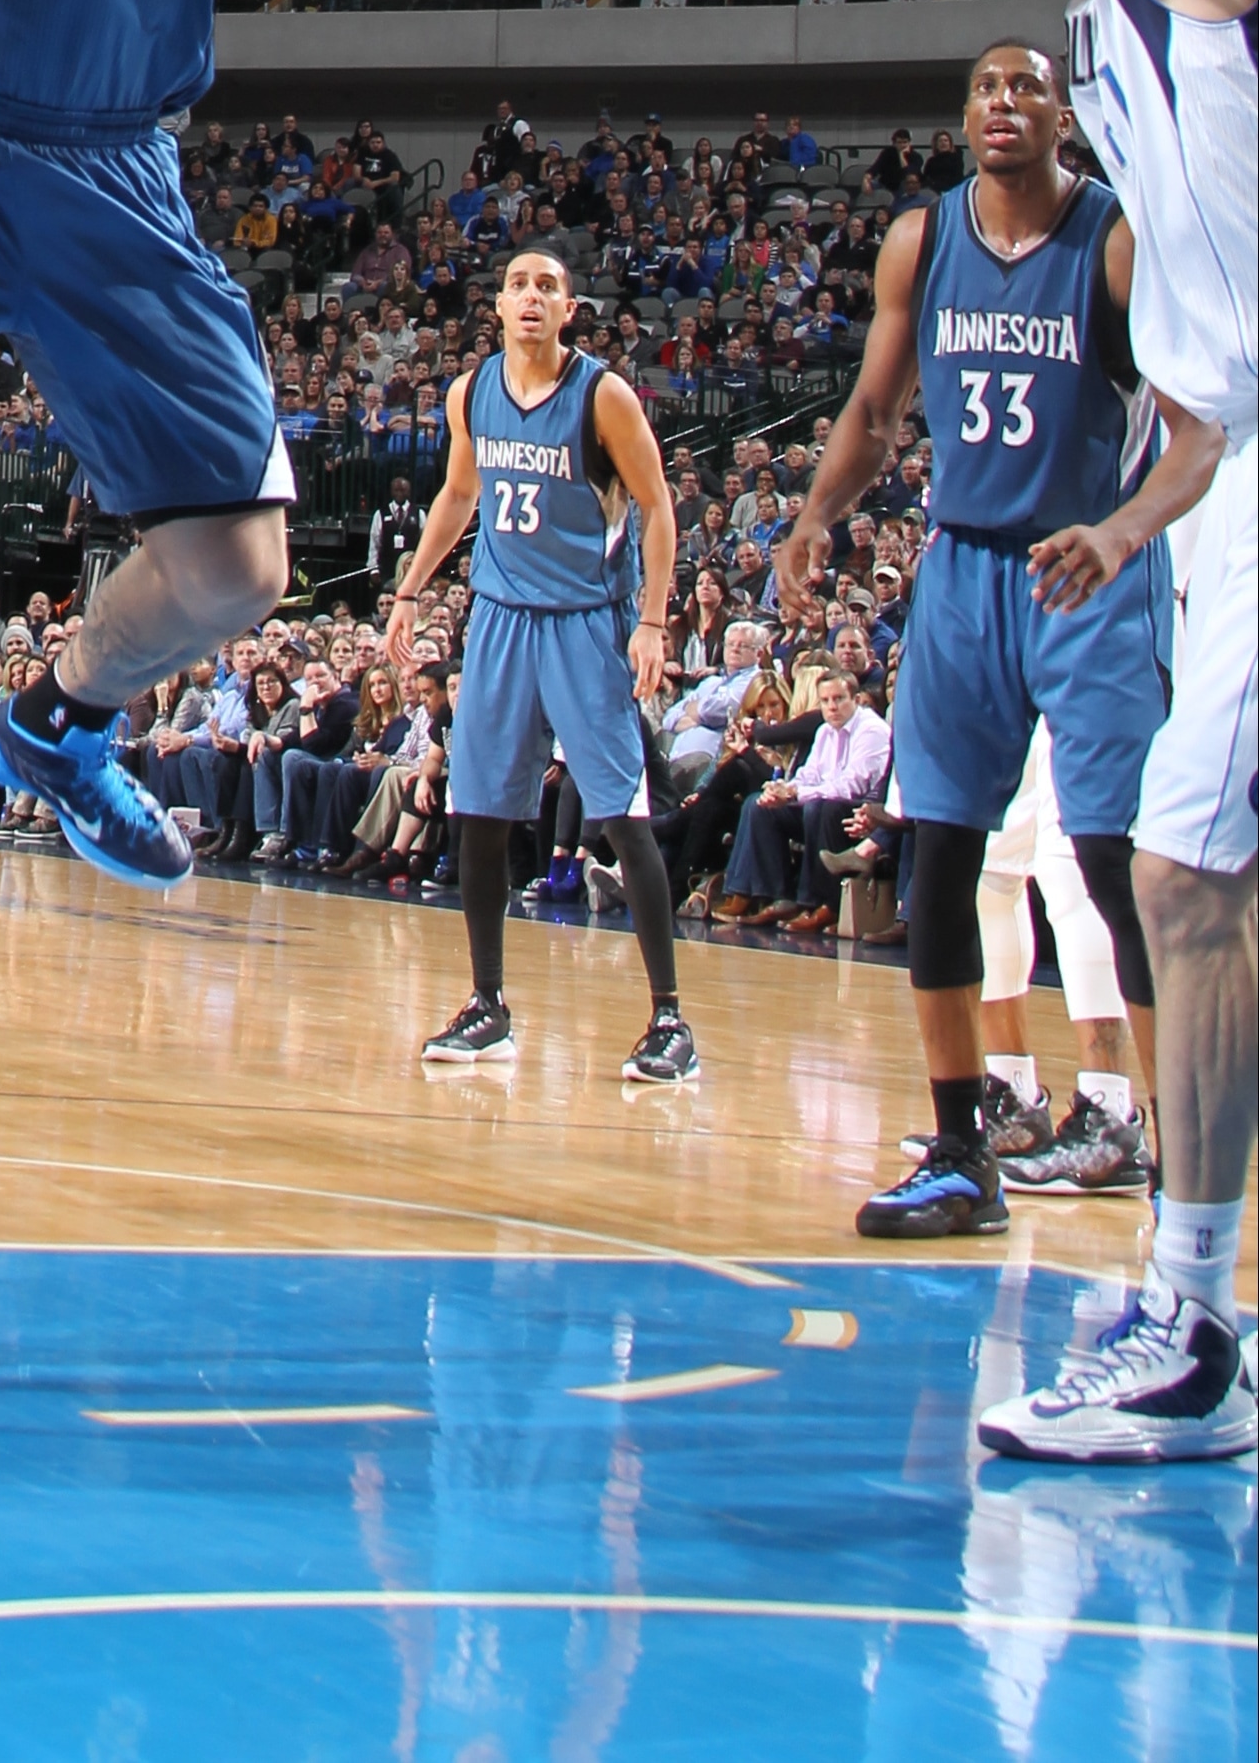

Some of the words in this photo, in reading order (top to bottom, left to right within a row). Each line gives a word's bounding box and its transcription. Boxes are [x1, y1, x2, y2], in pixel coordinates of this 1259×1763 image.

[933, 307, 1081, 366] MINNESOTA
[960, 369, 1035, 447] 33
[476, 436, 572, 481] MINNESOTA
[495, 480, 541, 534] 23
